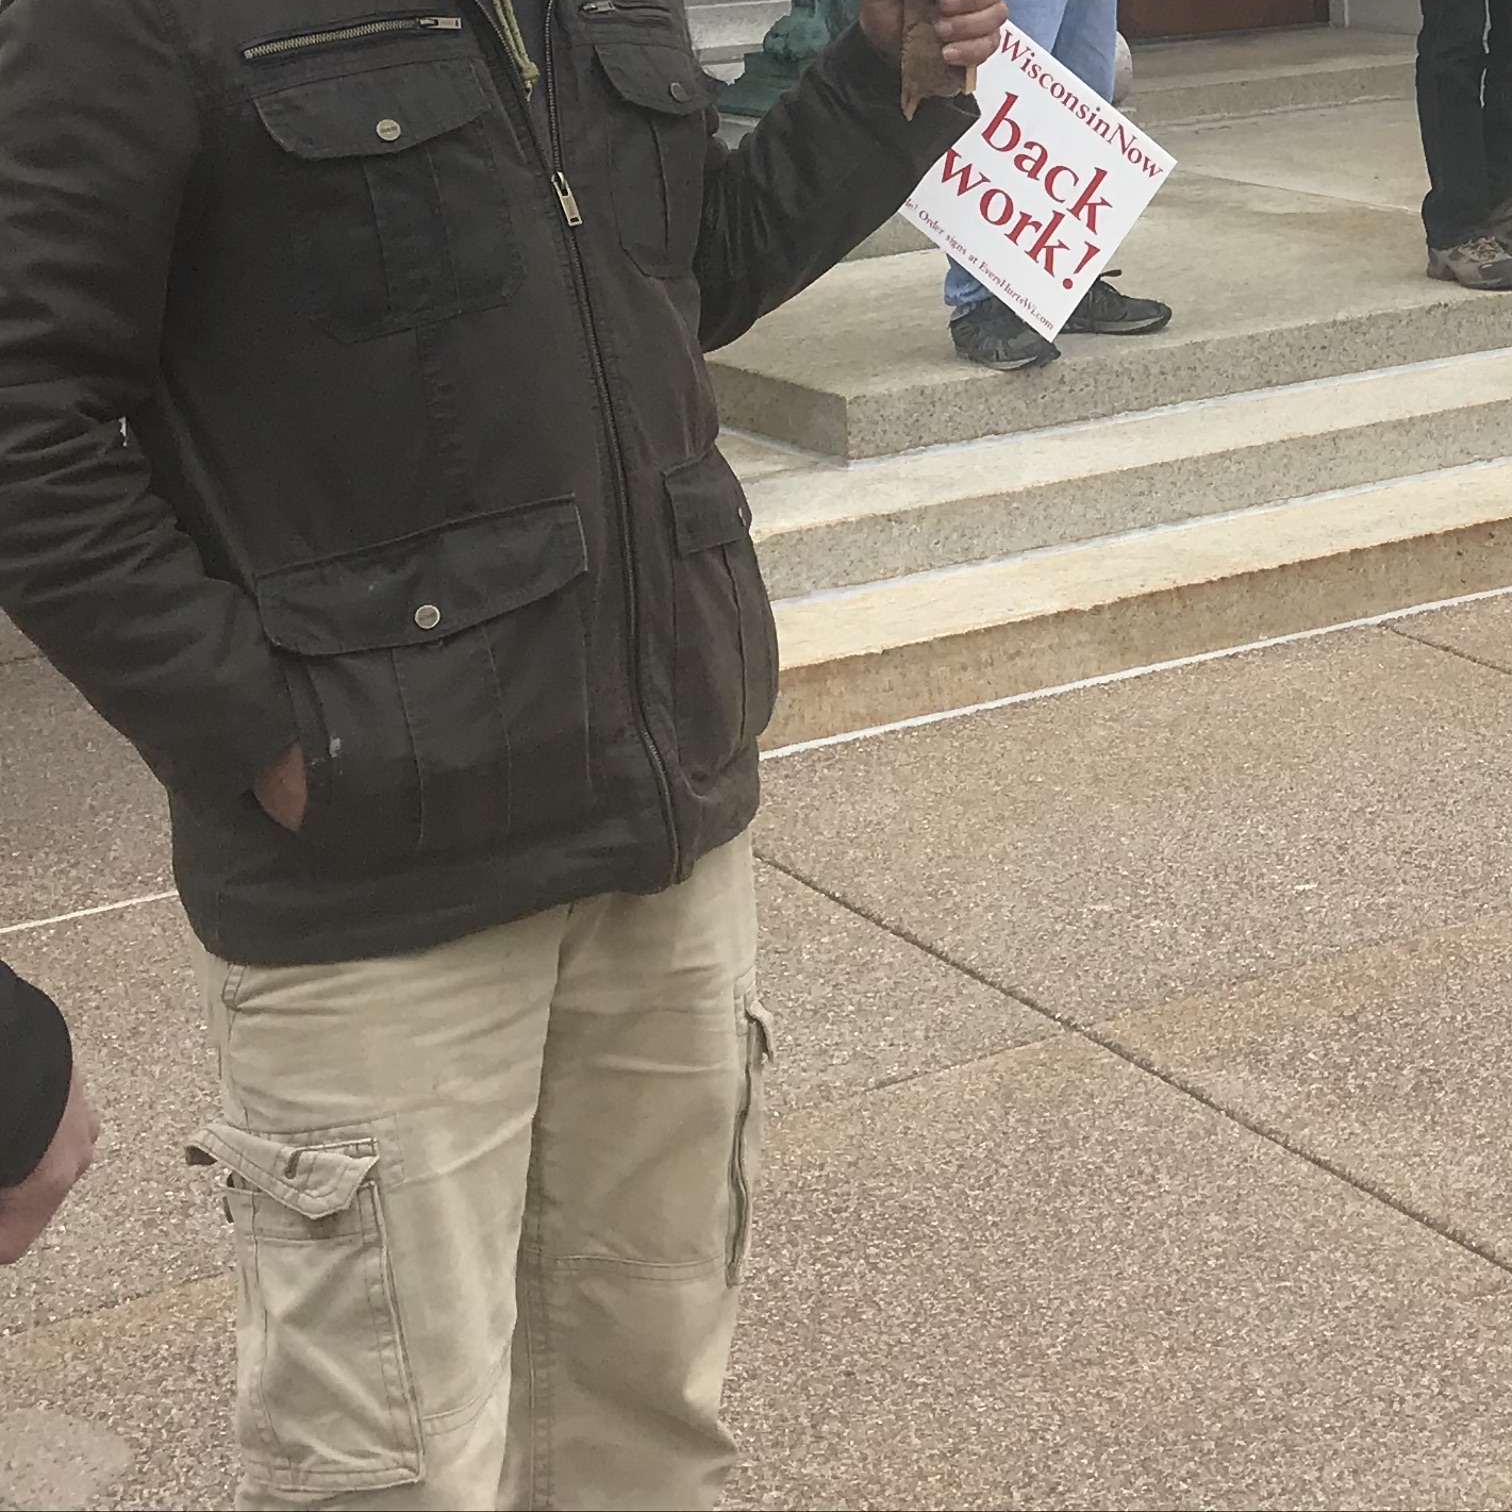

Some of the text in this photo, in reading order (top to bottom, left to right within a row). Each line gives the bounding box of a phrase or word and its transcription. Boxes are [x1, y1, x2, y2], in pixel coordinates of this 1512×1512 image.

[940, 147, 1101, 290] work!
[981, 91, 1112, 235] back
[919, 210, 944, 235] Order
[946, 234, 967, 255] signs
[968, 251, 978, 265] at
